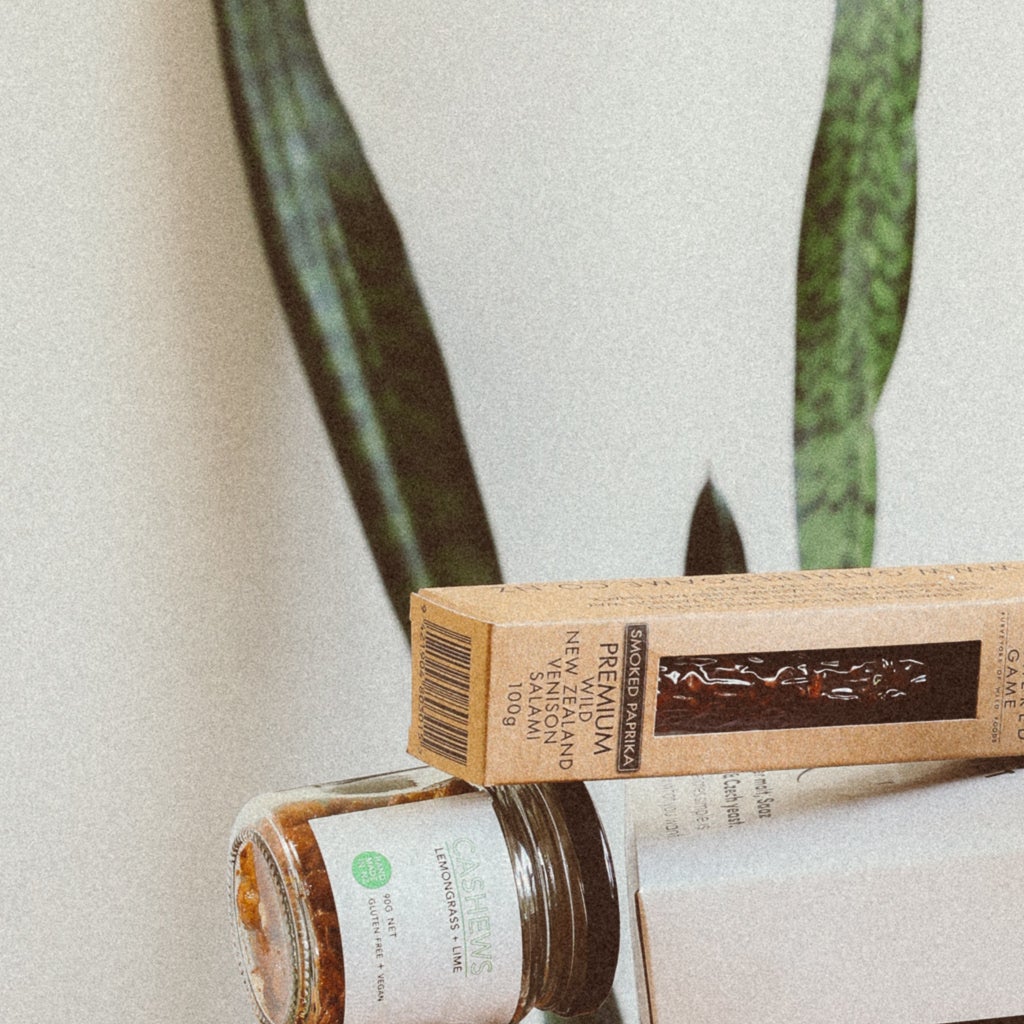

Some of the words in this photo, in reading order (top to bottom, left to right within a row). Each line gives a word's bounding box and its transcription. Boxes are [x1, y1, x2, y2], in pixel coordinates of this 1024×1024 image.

[564, 630, 580, 676] NEW
[626, 628, 644, 698] SMOKED
[1004, 648, 1020, 709] GAME
[502, 682, 523, 727] 100g
[526, 671, 545, 741] SALAMI
[543, 657, 563, 745] VENISON
[578, 676, 595, 724] WILD
[594, 642, 620, 756] PREMIUM
[558, 684, 579, 771] ZEALAND
[622, 701, 638, 768] PAPRIKA
[723, 779, 745, 803] Czech
[368, 898, 381, 935] GLUTEN
[383, 893, 394, 913] 90G
[387, 917, 398, 938] NET
[434, 847, 460, 931] LEMONGRASS
[452, 945, 463, 974] LIME
[452, 837, 494, 976] CASHEWS
[375, 937, 384, 959] FREE
[377, 973, 385, 1002] VEGAN
